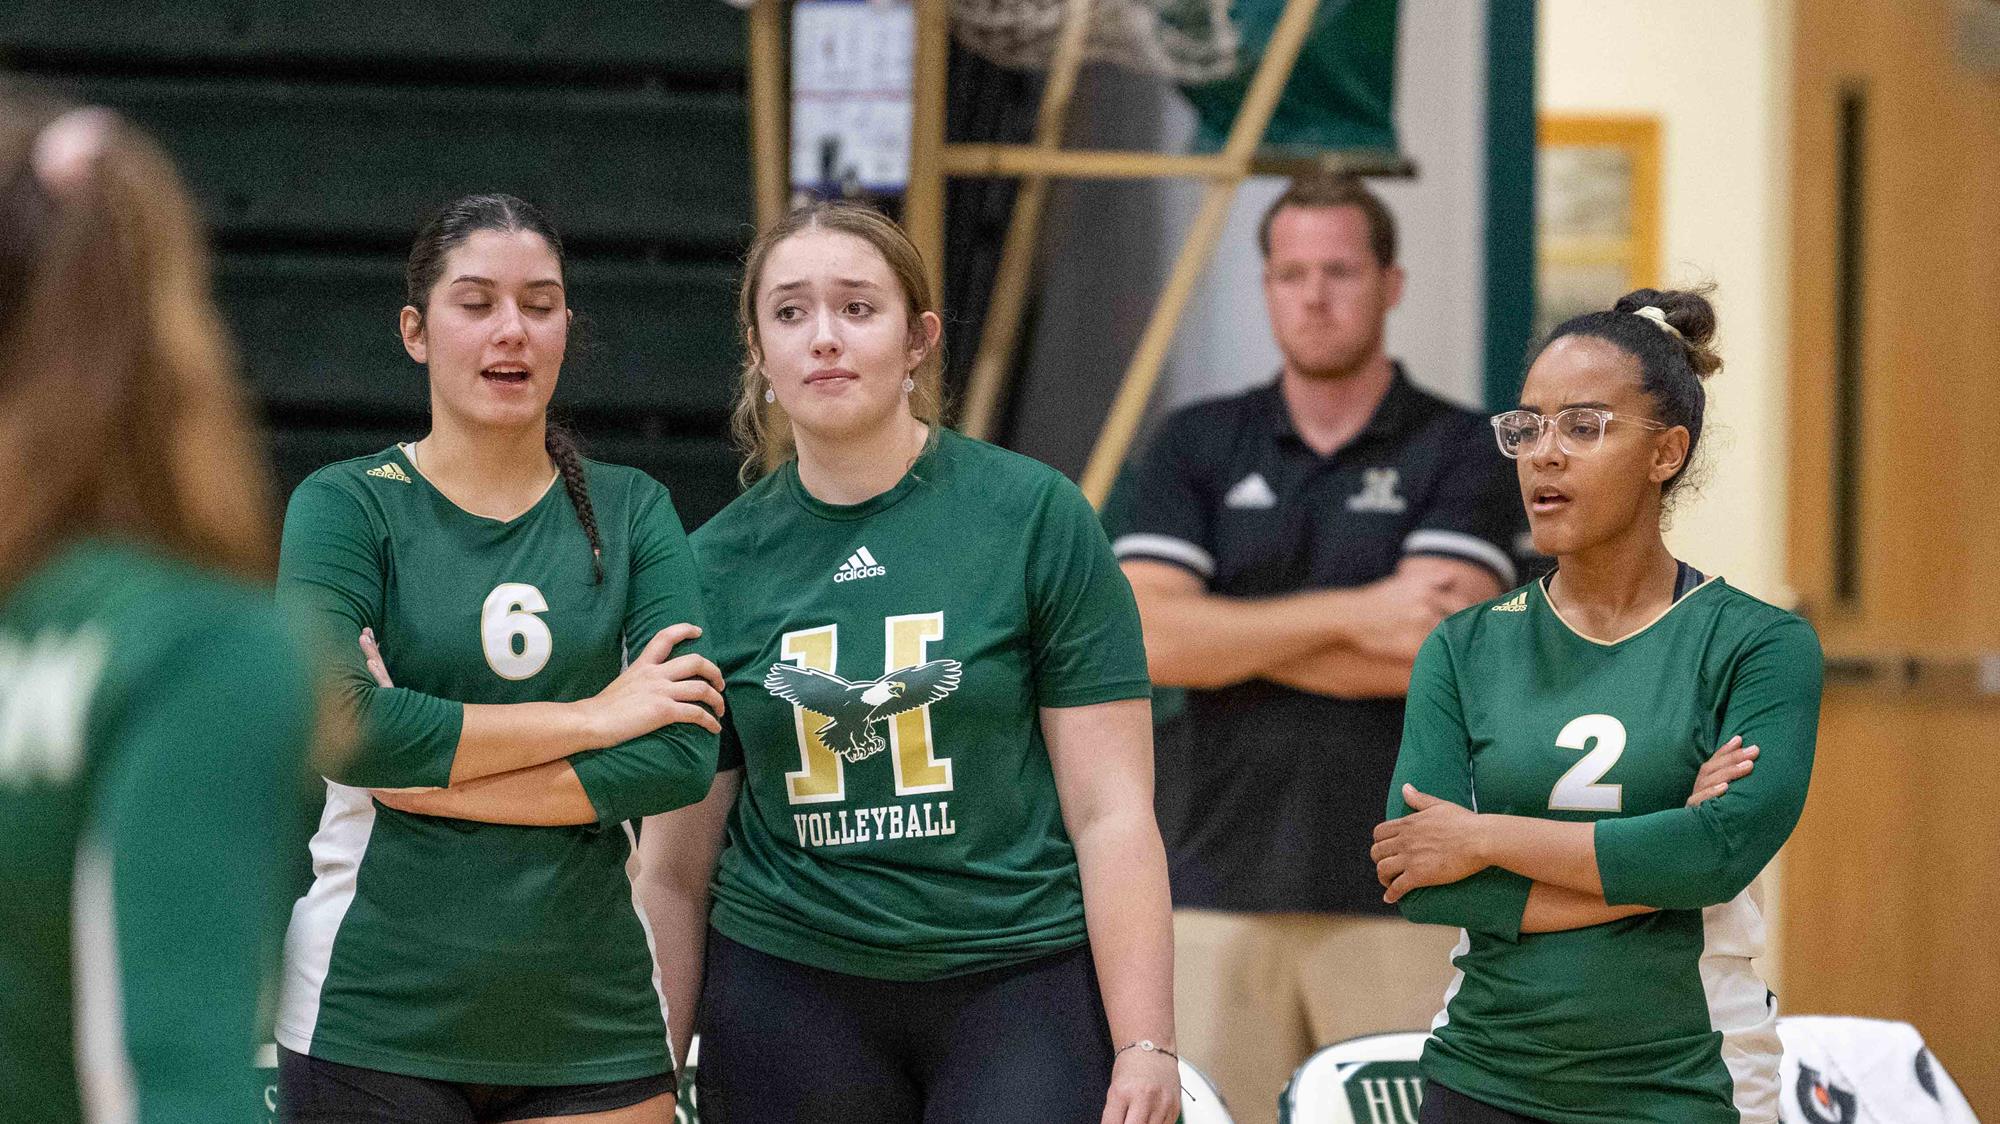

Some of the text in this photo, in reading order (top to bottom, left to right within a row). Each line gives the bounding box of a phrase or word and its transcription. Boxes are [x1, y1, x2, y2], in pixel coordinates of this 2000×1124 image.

[366, 469, 412, 484] adidas
[833, 565, 886, 583] adidas
[480, 582, 553, 681] 6
[1547, 713, 1627, 813] 2
[793, 801, 956, 848] VOLLEYBALL
